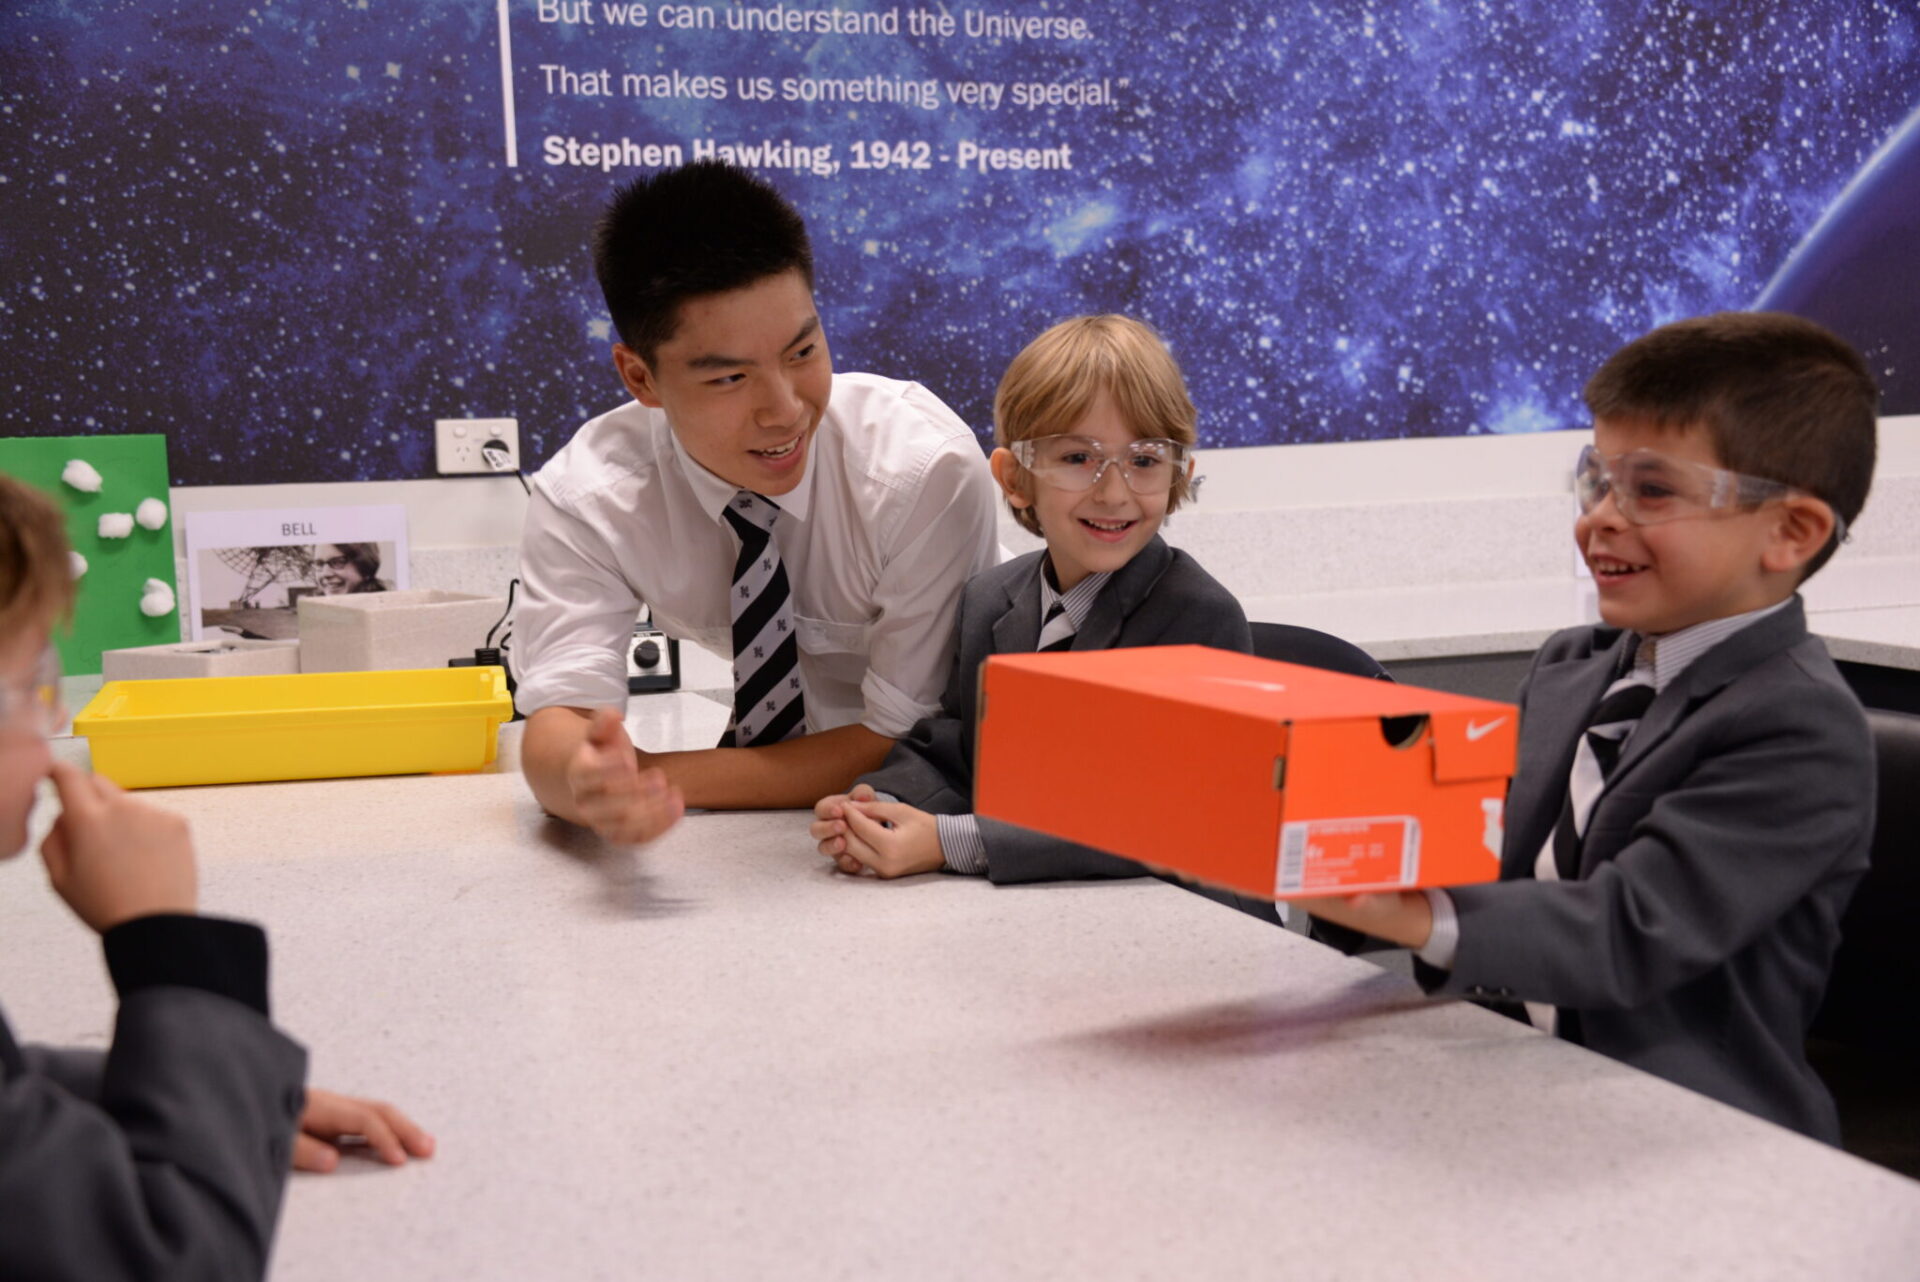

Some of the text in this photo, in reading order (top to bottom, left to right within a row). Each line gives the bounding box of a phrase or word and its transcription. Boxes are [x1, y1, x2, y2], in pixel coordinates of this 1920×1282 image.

[538, 0, 1094, 40] But we can understand the Universe.
[539, 64, 613, 97] That
[622, 69, 728, 100] makes
[737, 77, 773, 101] us
[782, 74, 940, 110] something
[946, 82, 1005, 111] very
[543, 136, 1073, 175] Stephen Hawking, 1942 - Present
[282, 522, 317, 537] BELL
